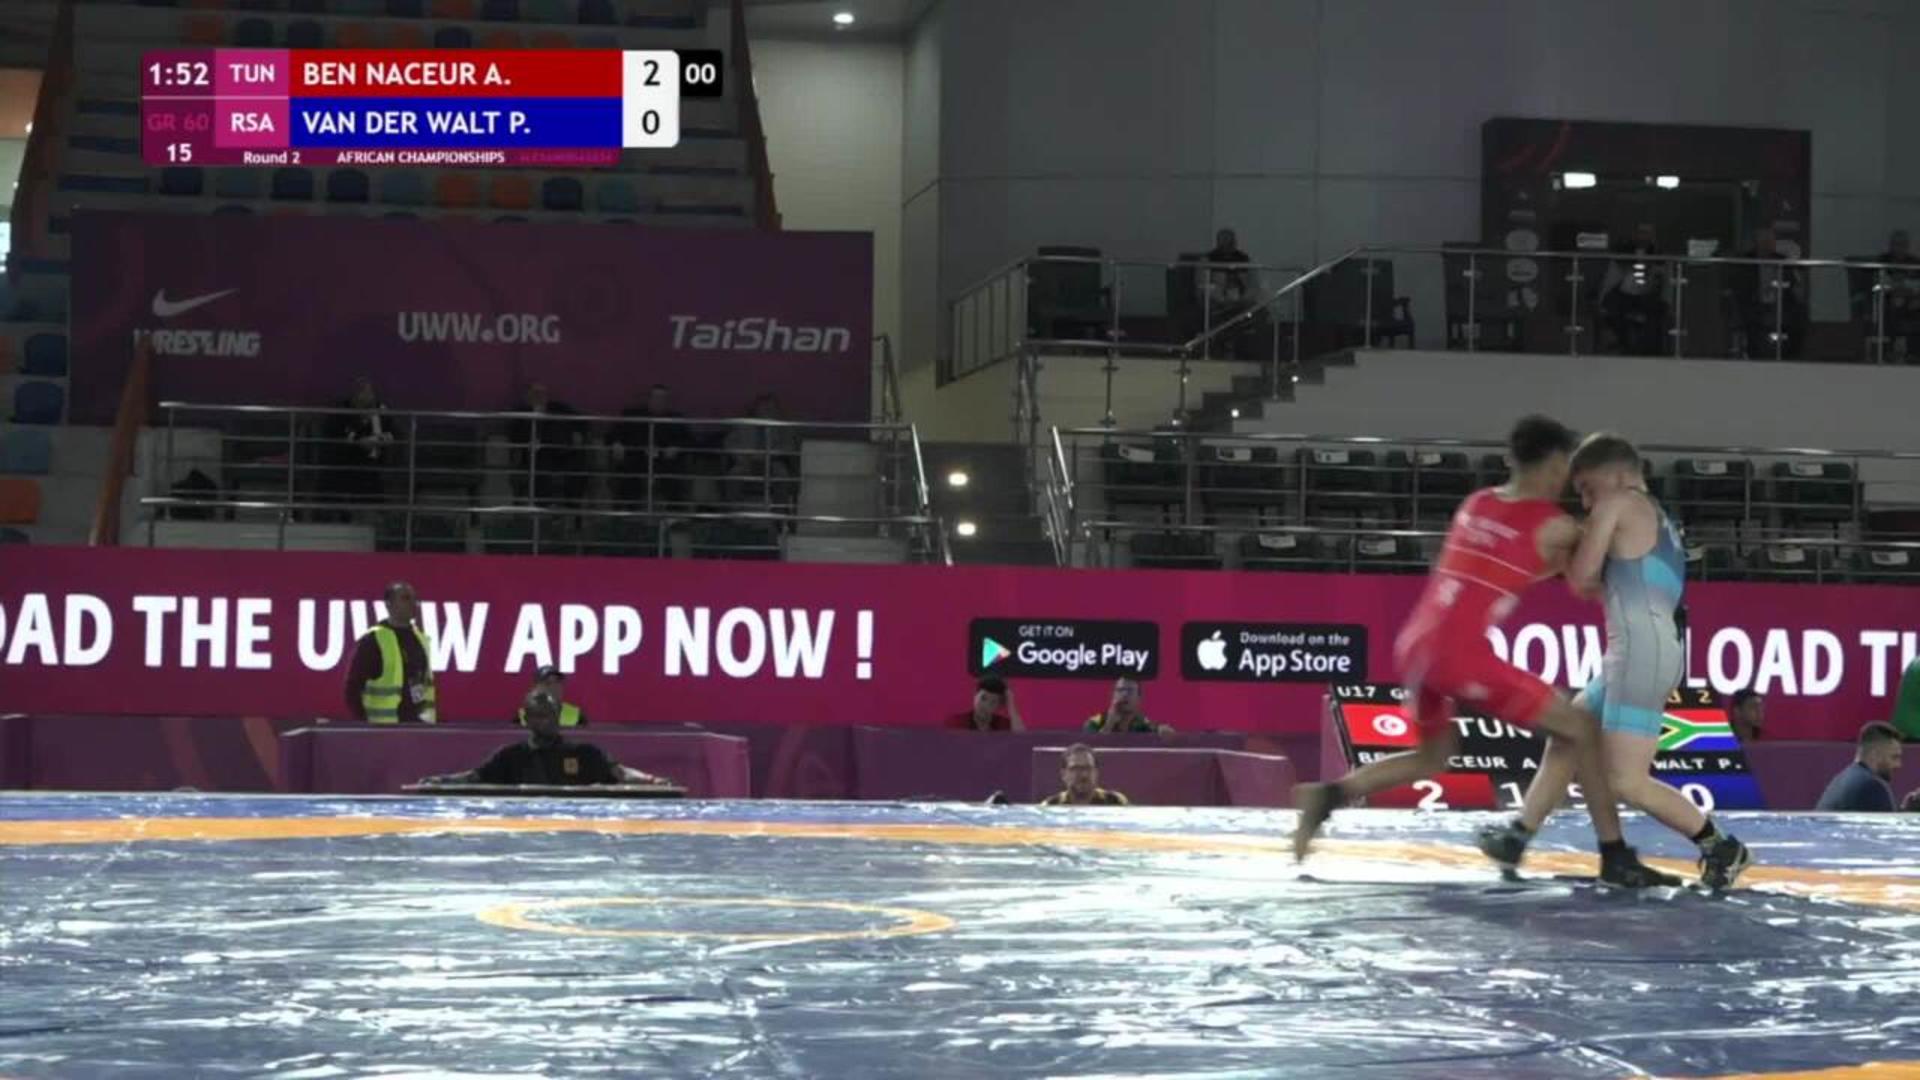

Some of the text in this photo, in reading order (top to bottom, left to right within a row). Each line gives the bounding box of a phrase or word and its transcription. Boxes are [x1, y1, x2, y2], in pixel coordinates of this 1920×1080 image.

[398, 312, 561, 344] UWW.ORG
[669, 316, 850, 353] TaiShan
[0, 593, 113, 666] AD
[132, 596, 272, 668] THE
[503, 603, 643, 676] APP
[664, 606, 836, 679] NOW
[855, 610, 874, 679] !
[1019, 626, 1041, 637] GET
[1055, 627, 1074, 638] ON
[1239, 631, 1350, 646] Download on the
[1017, 641, 1149, 670] Google Play
[1238, 649, 1351, 677] App Store
[1486, 623, 1844, 695] OWLOAD
[1336, 686, 1377, 698] U17
[1445, 755, 1509, 769] CEUR
[1654, 758, 1705, 770] WALT
[1718, 760, 1742, 770] P.
[1412, 780, 1449, 810] 2
[1680, 782, 1716, 816] 0
